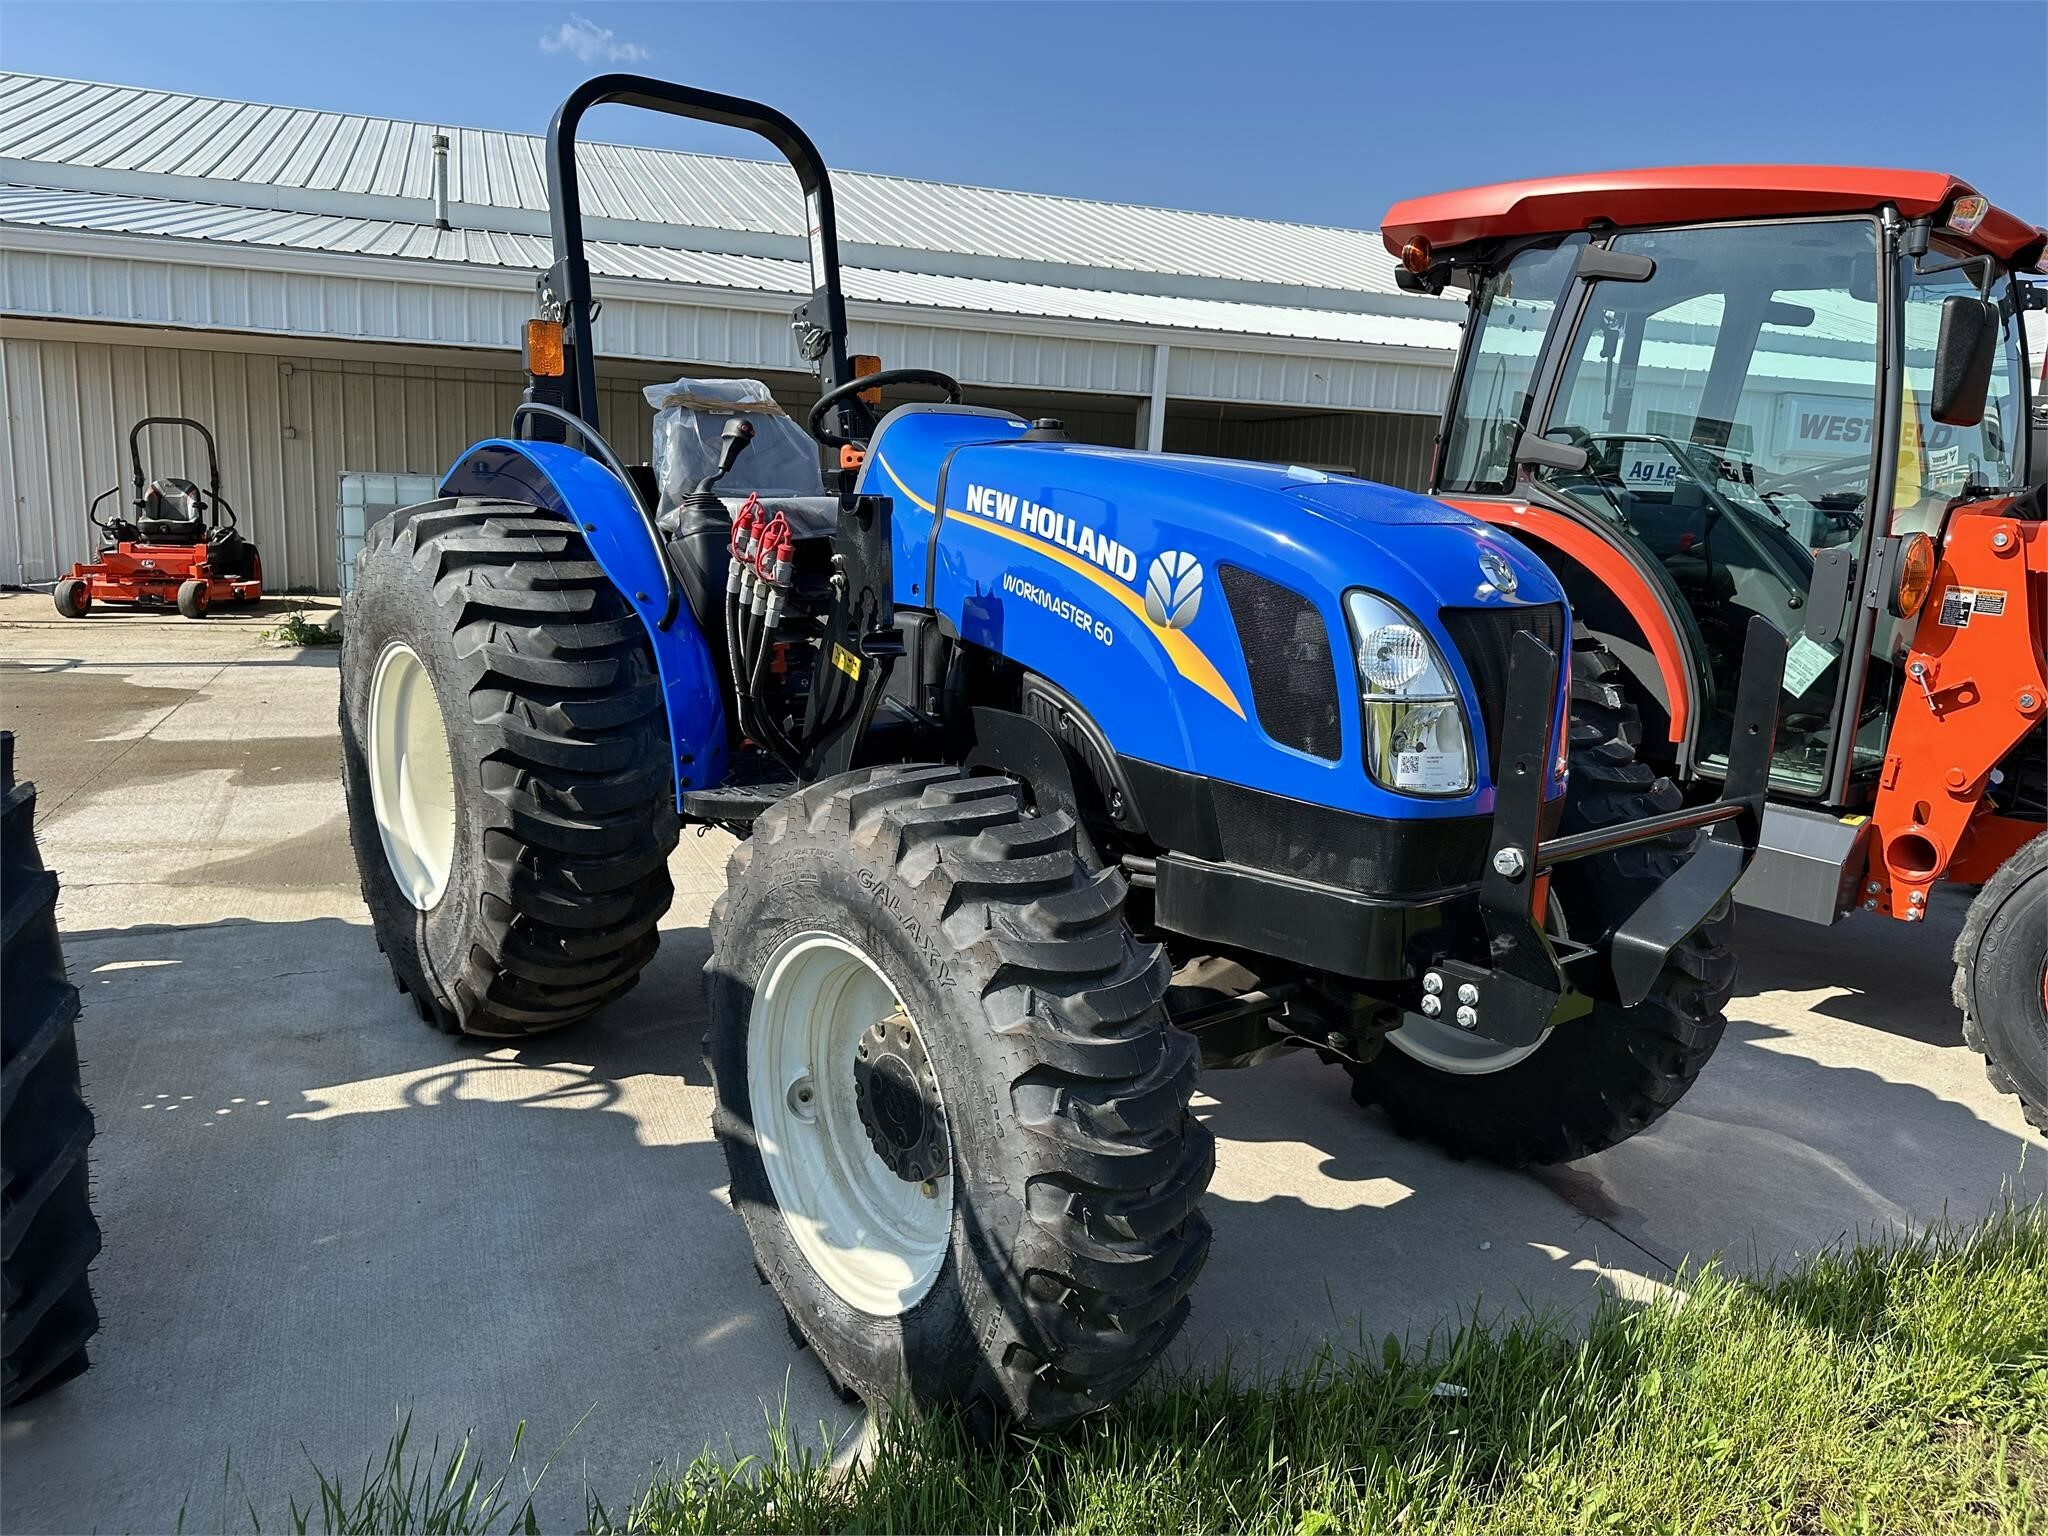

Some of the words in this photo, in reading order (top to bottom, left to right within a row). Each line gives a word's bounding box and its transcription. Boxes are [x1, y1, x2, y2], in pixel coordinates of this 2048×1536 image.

[1800, 413, 1953, 449] WESTELD
[1629, 461, 1655, 481] Ag
[1656, 462, 1682, 480] Lea
[966, 484, 1018, 524] NEW
[1020, 501, 1138, 582] HOLLAND
[1003, 573, 1092, 633] WORKMASTER
[1094, 621, 1113, 646] 60
[856, 868, 957, 986] GALAXY
